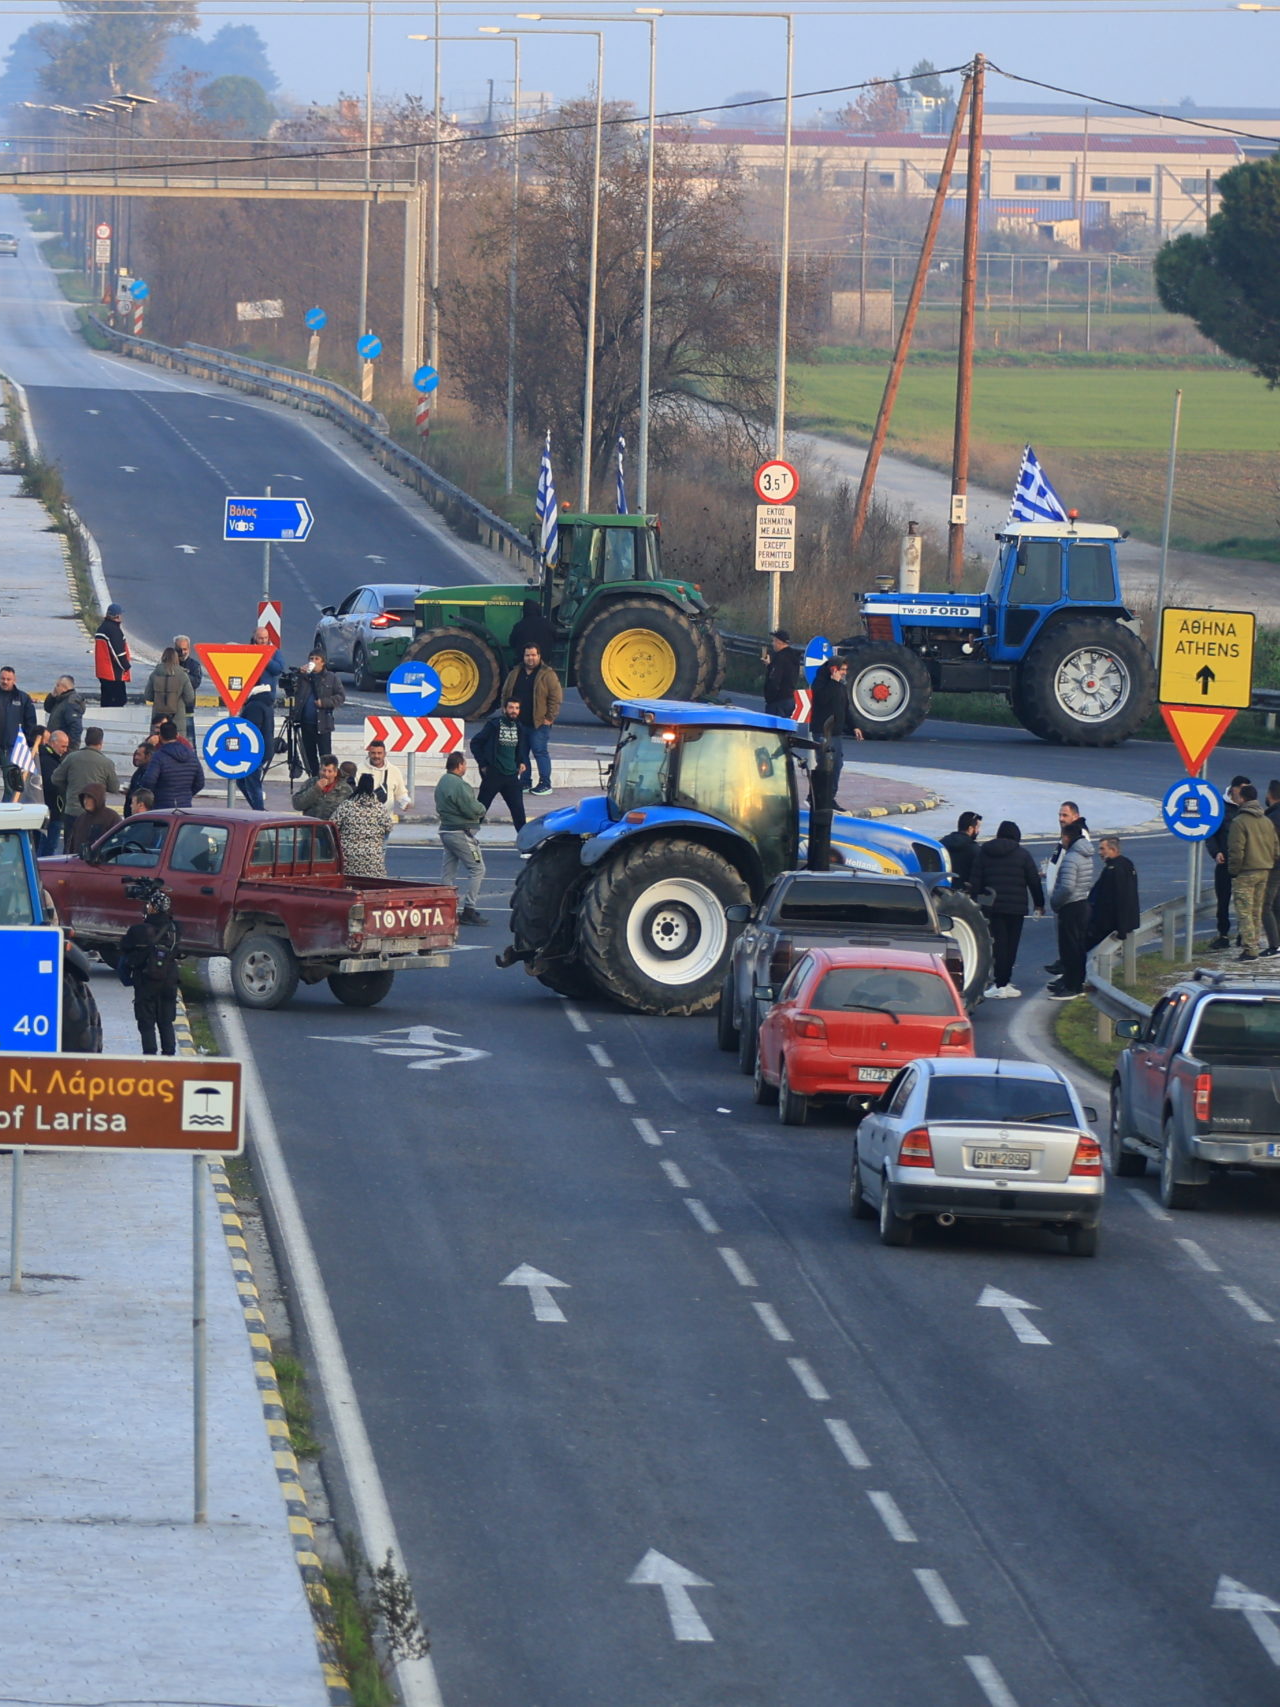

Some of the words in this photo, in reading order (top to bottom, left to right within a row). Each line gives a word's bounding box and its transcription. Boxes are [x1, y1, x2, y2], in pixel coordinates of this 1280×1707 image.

[229, 504, 257, 519] Βόλος
[767, 508, 785, 516] ΕΚΤΟΣ
[229, 519, 255, 532] Voos
[761, 527, 771, 535] ΜΕ
[772, 527, 791, 535] ΑΔΕΙΑ
[763, 541, 787, 549] EXCEPT
[758, 551, 792, 559] PERMITTED
[760, 560, 790, 569] VEHICLES
[930, 607, 969, 616] FORD
[1179, 620, 1237, 637] ΑΘΗΝΑ
[1175, 641, 1240, 658] ATHENS
[845, 858, 882, 872] Holland
[372, 907, 444, 928] TOYOTA
[13, 1015, 50, 1036] 40
[9, 1069, 38, 1094] Ν.
[47, 1068, 175, 1102] Λάρισας
[36, 1106, 127, 1132] Larisa
